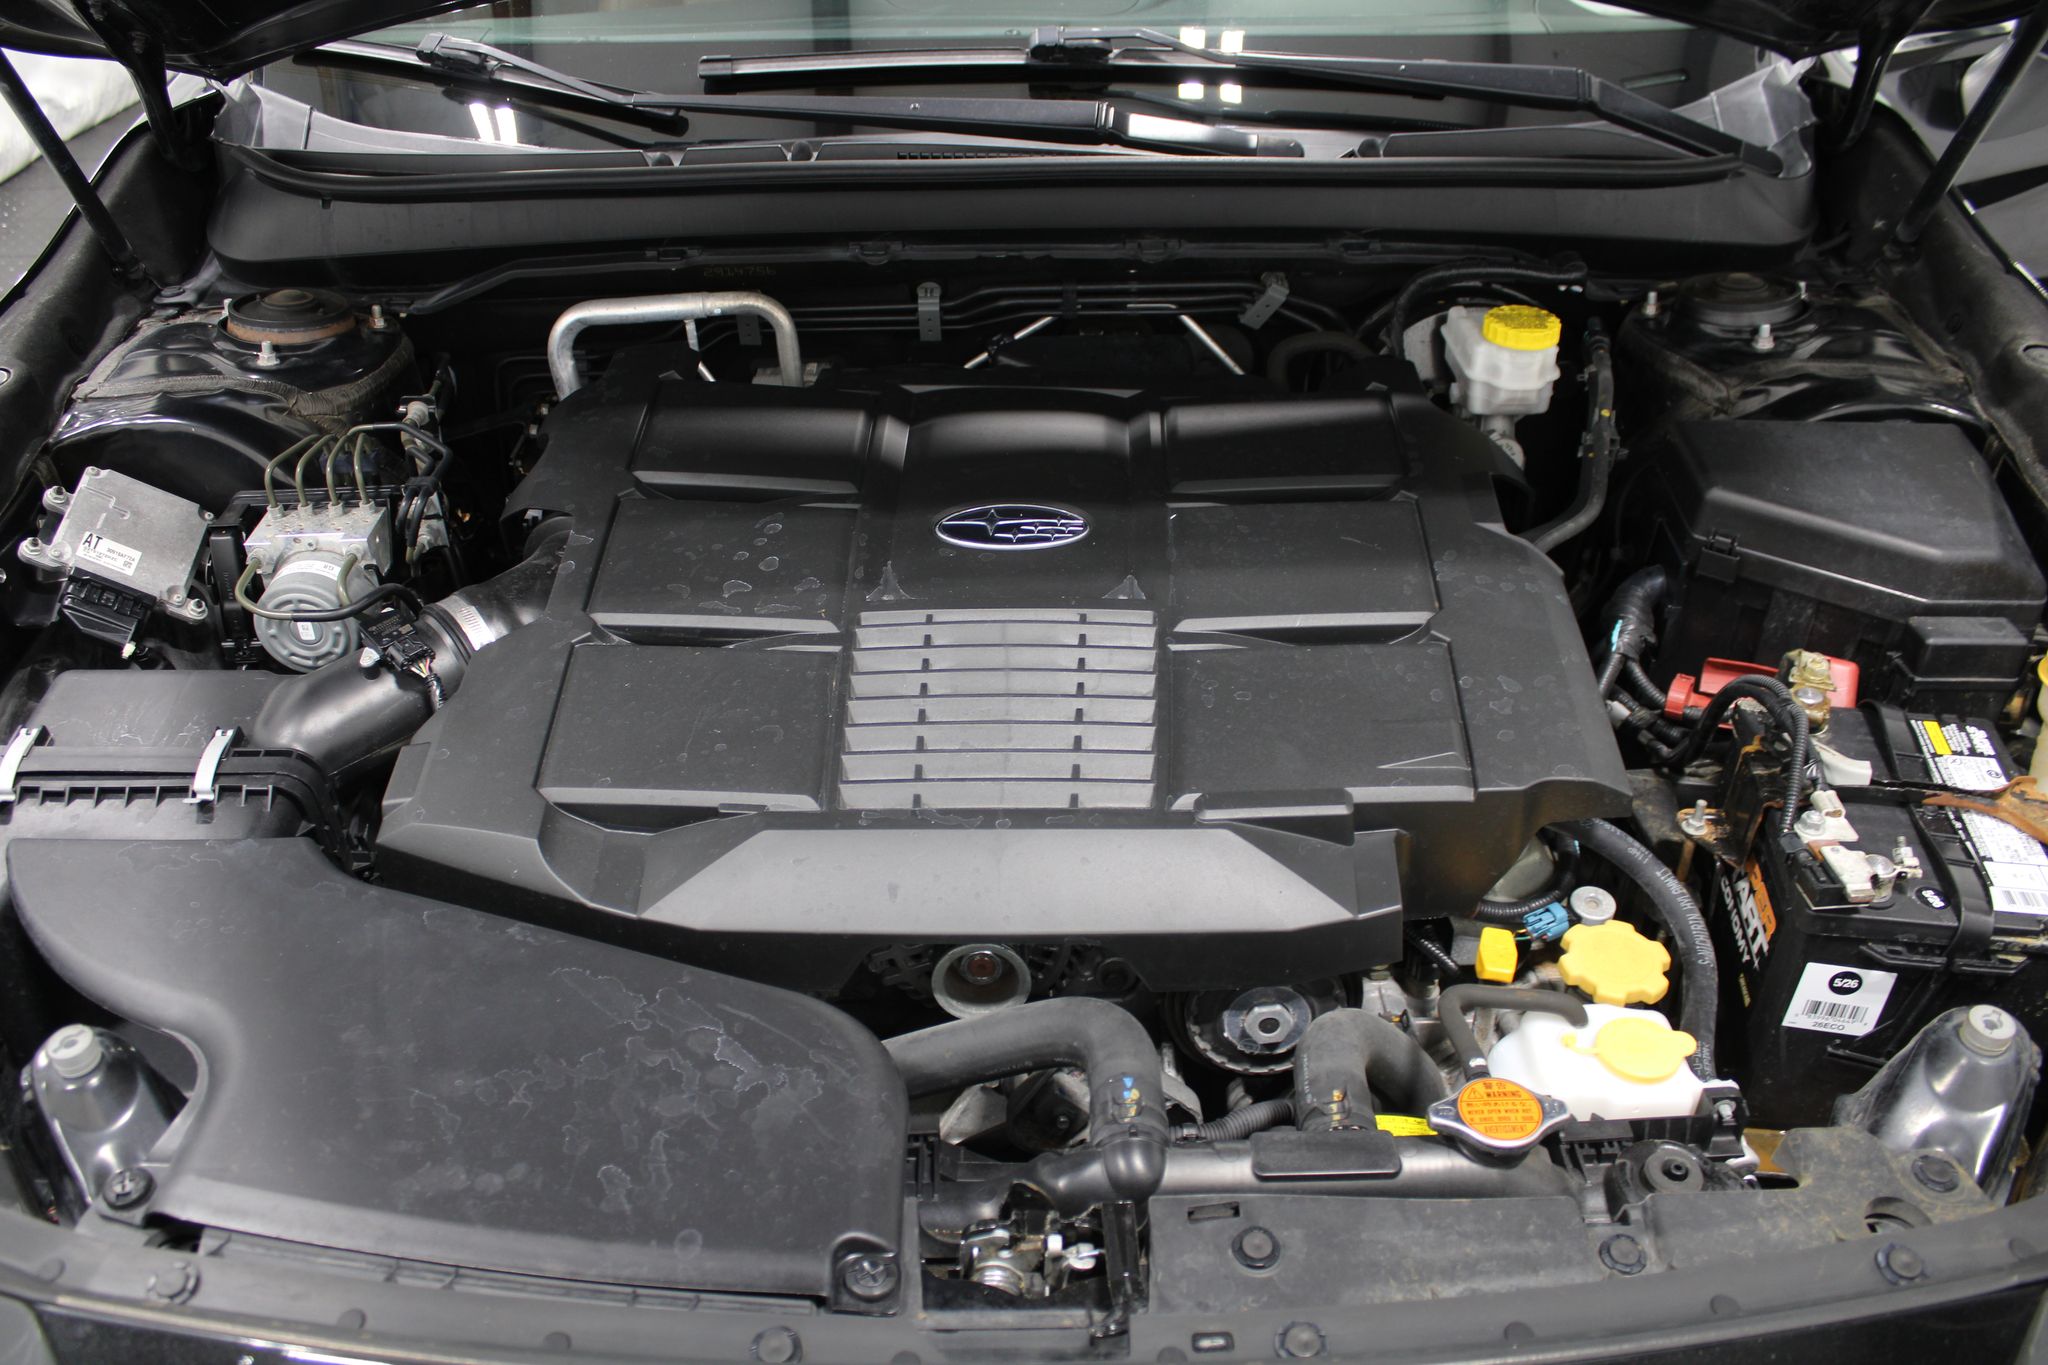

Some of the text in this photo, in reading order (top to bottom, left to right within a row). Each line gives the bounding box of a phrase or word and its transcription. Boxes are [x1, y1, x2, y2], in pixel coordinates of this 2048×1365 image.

[82, 533, 103, 550] AT
[1720, 875, 1752, 963] CONOMY
[1832, 977, 1860, 989] 5/26
[1811, 1020, 1846, 1032] 26ECO
